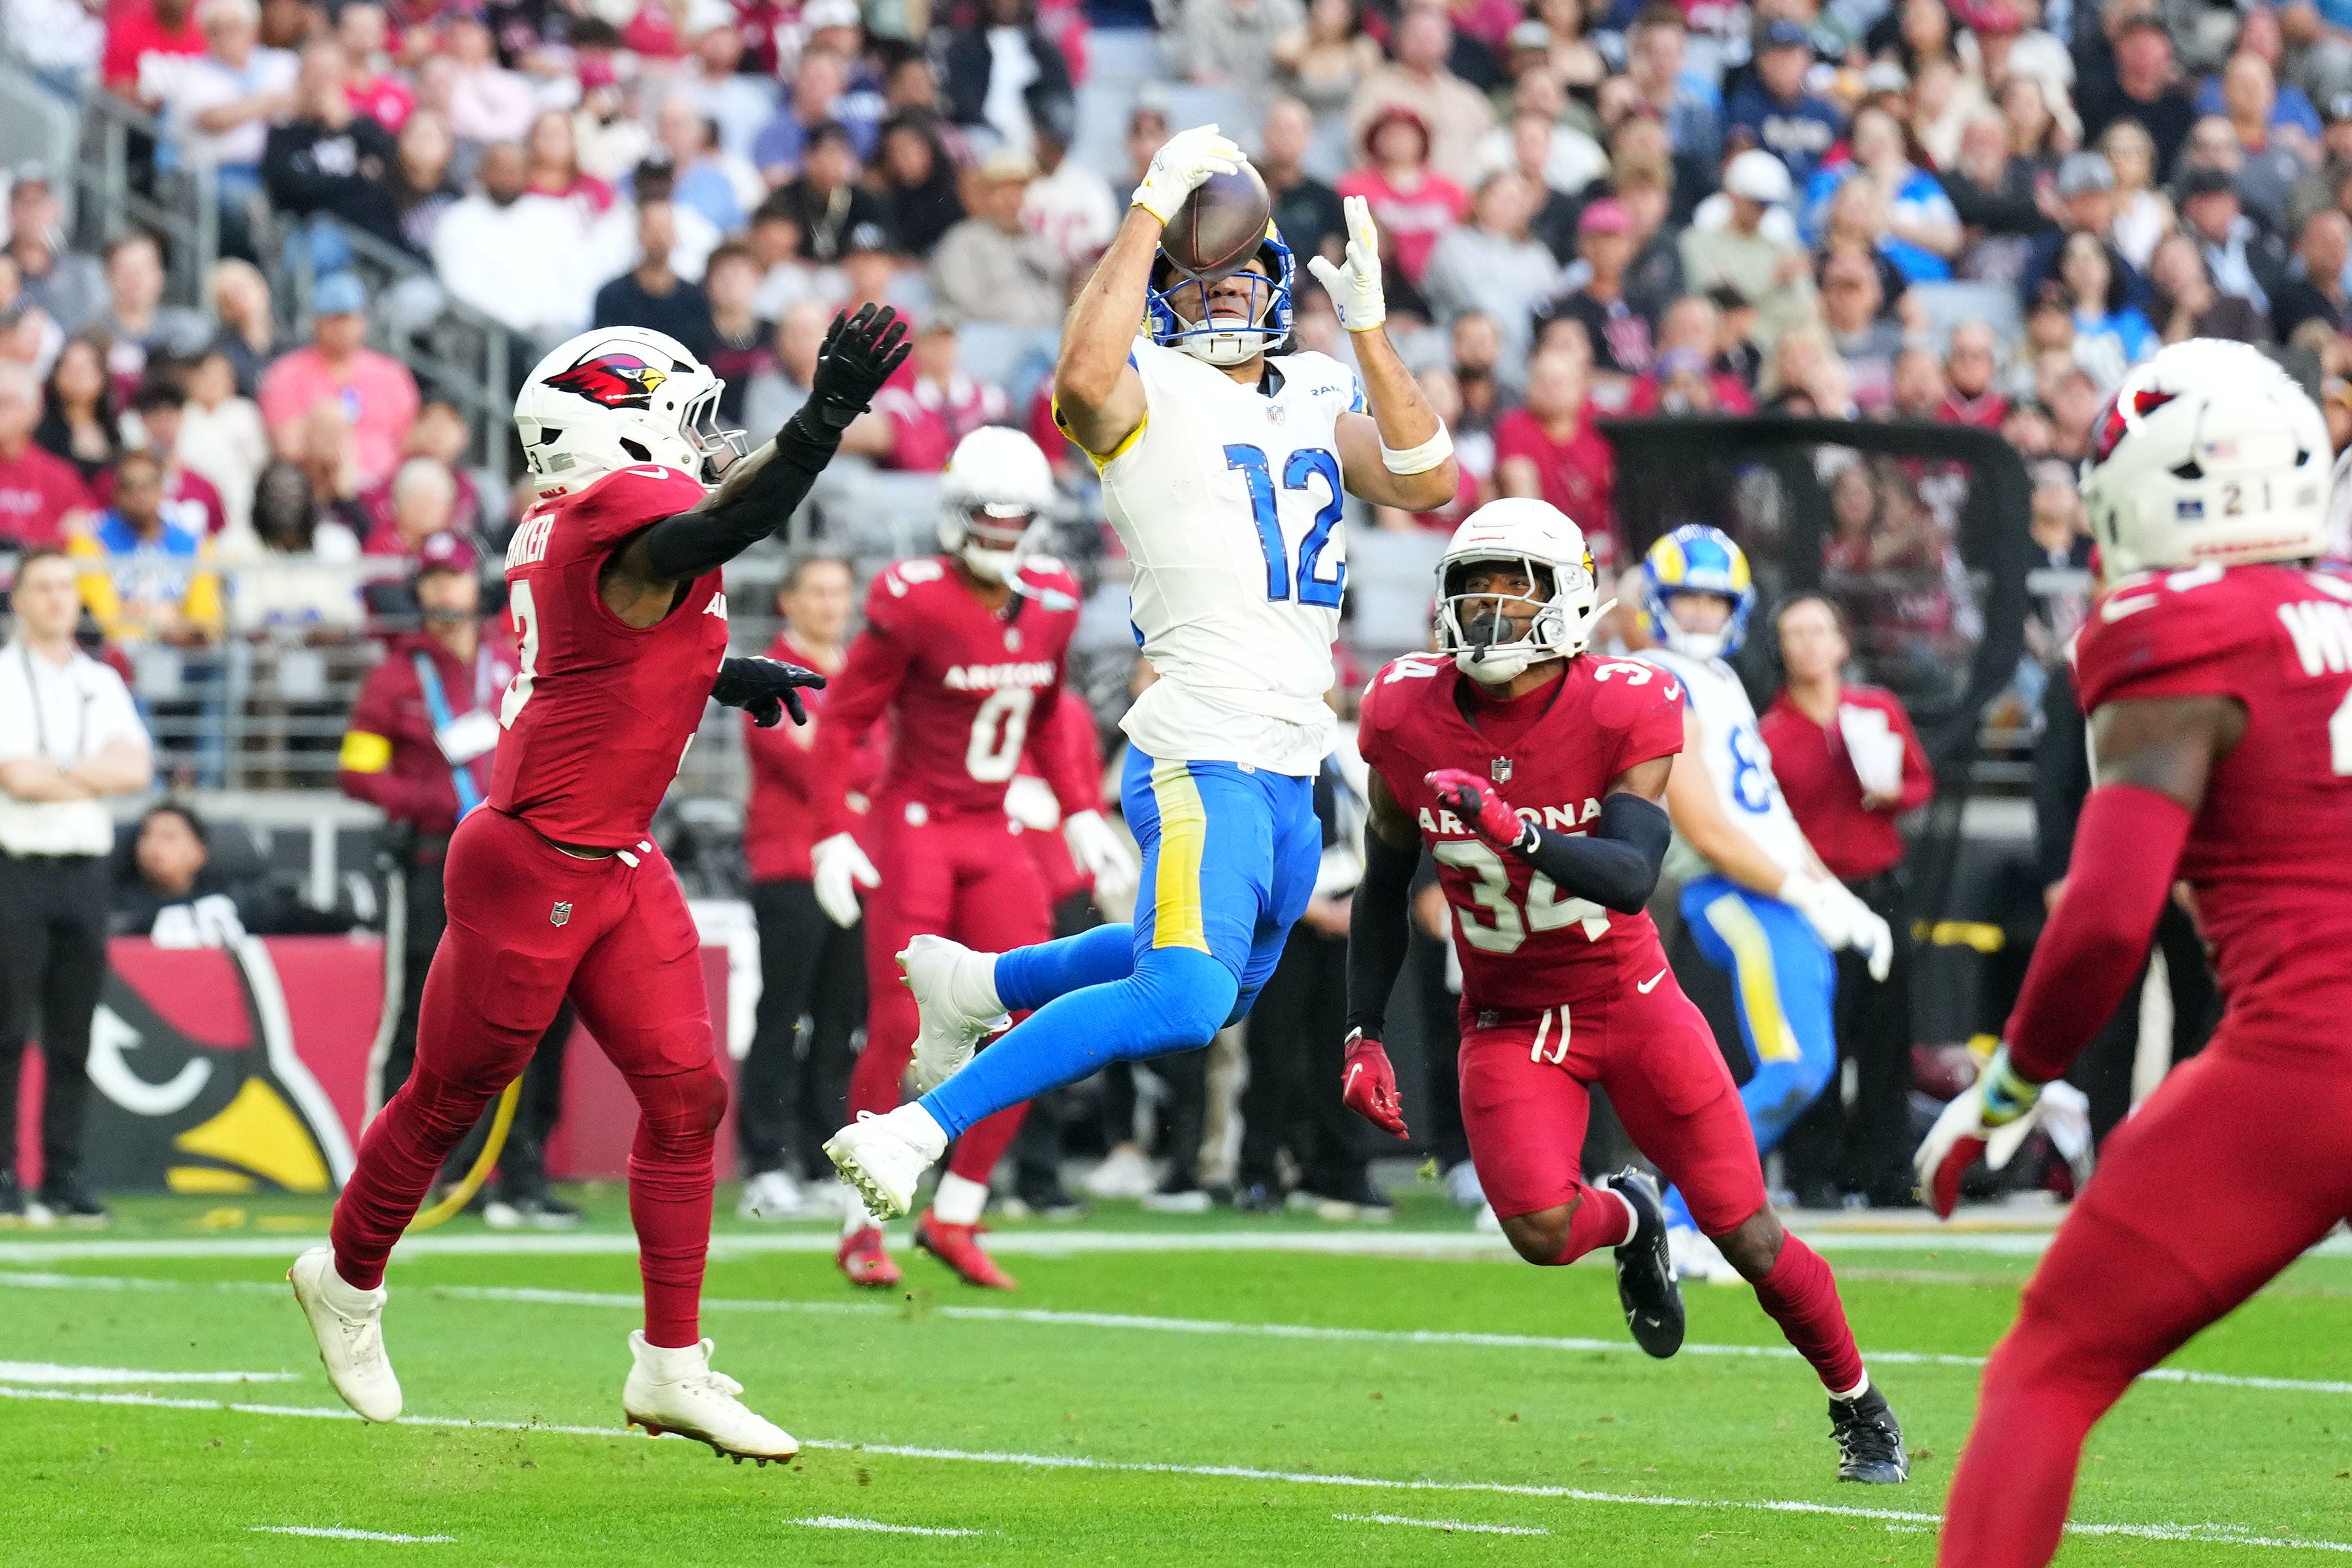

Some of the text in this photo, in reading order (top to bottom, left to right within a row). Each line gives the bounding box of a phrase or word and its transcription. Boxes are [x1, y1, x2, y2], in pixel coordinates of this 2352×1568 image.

[530, 451, 543, 474] 3
[504, 514, 556, 571] BAKER
[1222, 444, 1345, 609] 12
[499, 580, 540, 730] 3
[966, 687, 1034, 783] 0
[1418, 797, 1601, 834] ARONA
[1432, 830, 1611, 954] 34
